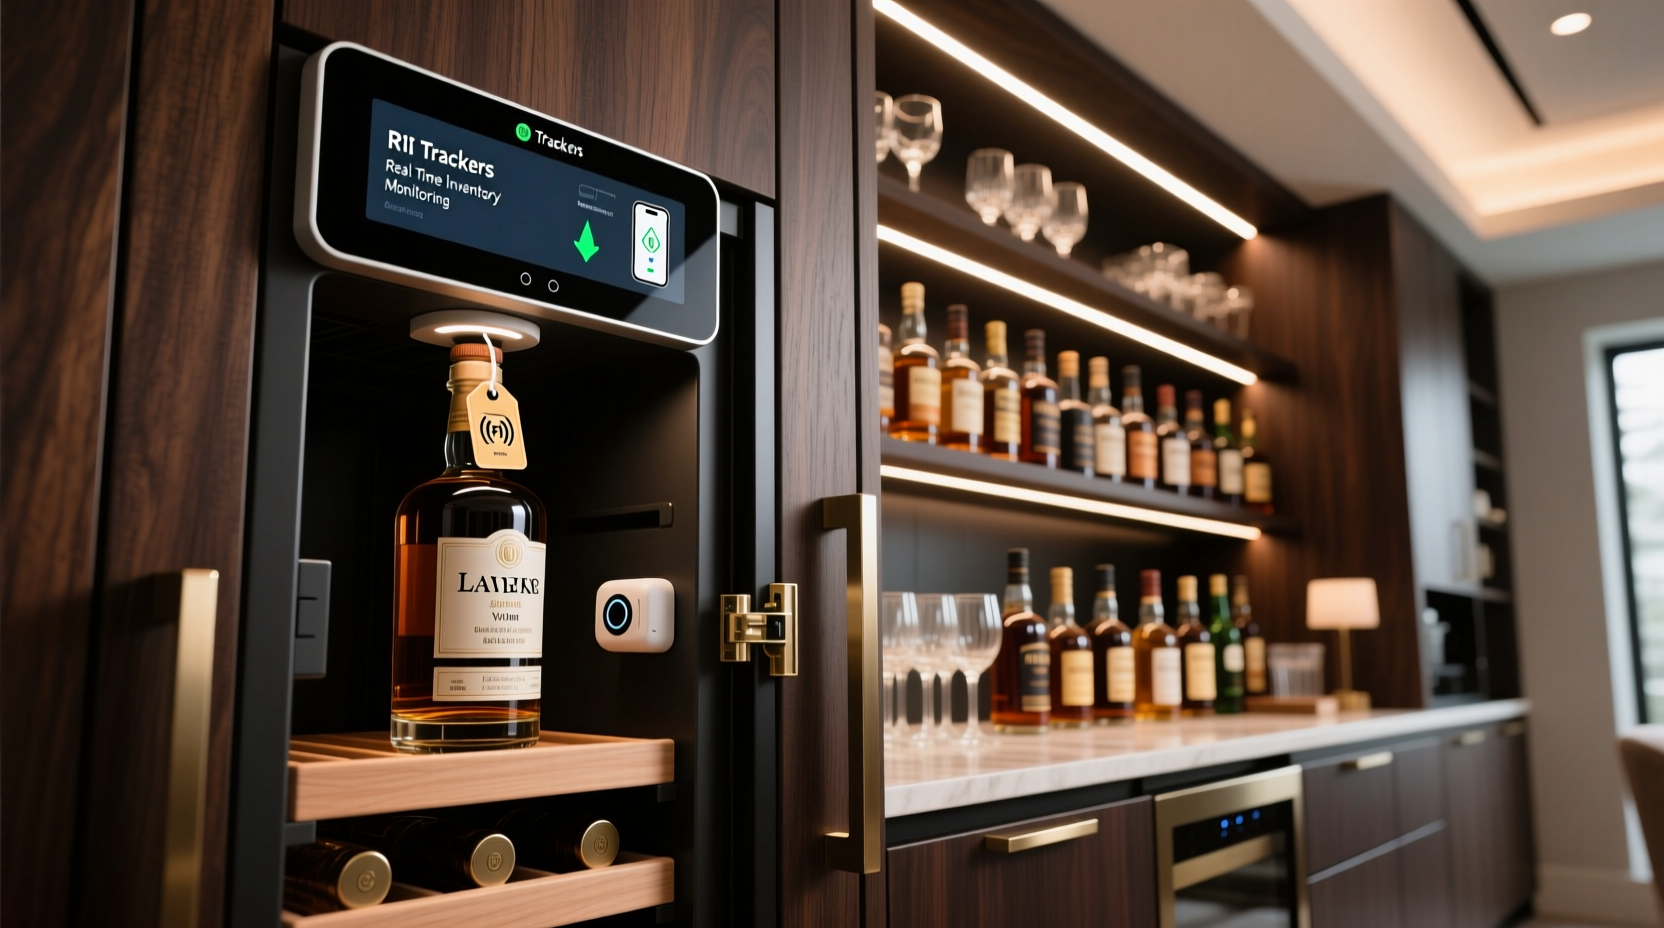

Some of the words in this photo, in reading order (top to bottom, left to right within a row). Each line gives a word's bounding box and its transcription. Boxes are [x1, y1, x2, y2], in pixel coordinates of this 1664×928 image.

[420, 139, 494, 178] Trackers
[535, 129, 583, 157] Trackers
[385, 178, 450, 210] Monitoring
[386, 158, 412, 178] Real
[446, 174, 502, 207] Inventory
